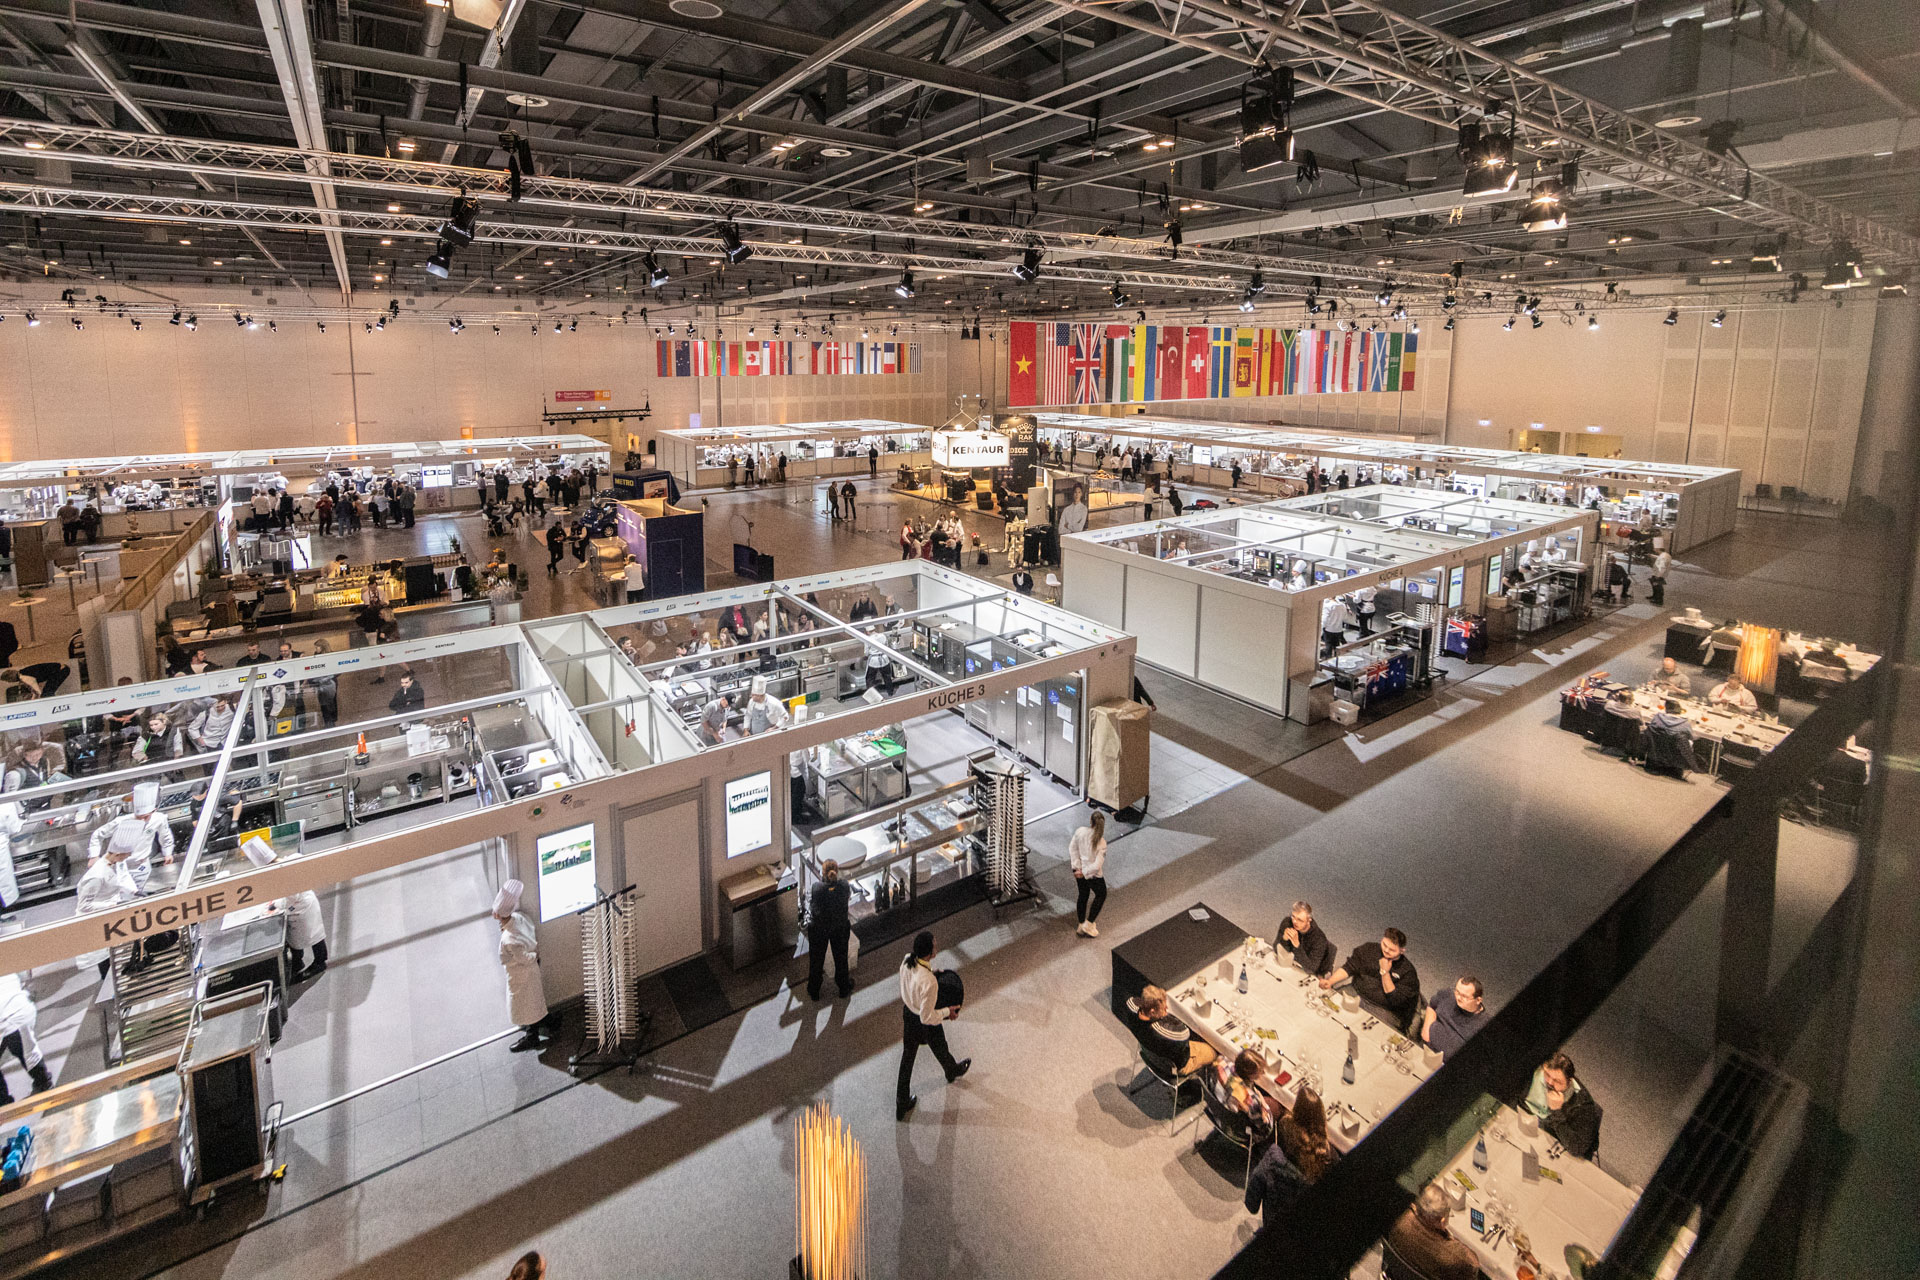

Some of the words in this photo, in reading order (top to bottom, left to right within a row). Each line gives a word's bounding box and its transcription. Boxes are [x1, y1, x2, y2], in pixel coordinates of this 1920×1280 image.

[953, 445, 1004, 454] KENTAUR
[615, 477, 635, 486] METRO
[338, 658, 360, 666] ECOLAB
[928, 687, 974, 710] KÜCHE
[978, 684, 985, 696] 3
[104, 892, 226, 942] KÜCHE
[236, 885, 254, 905] 2
